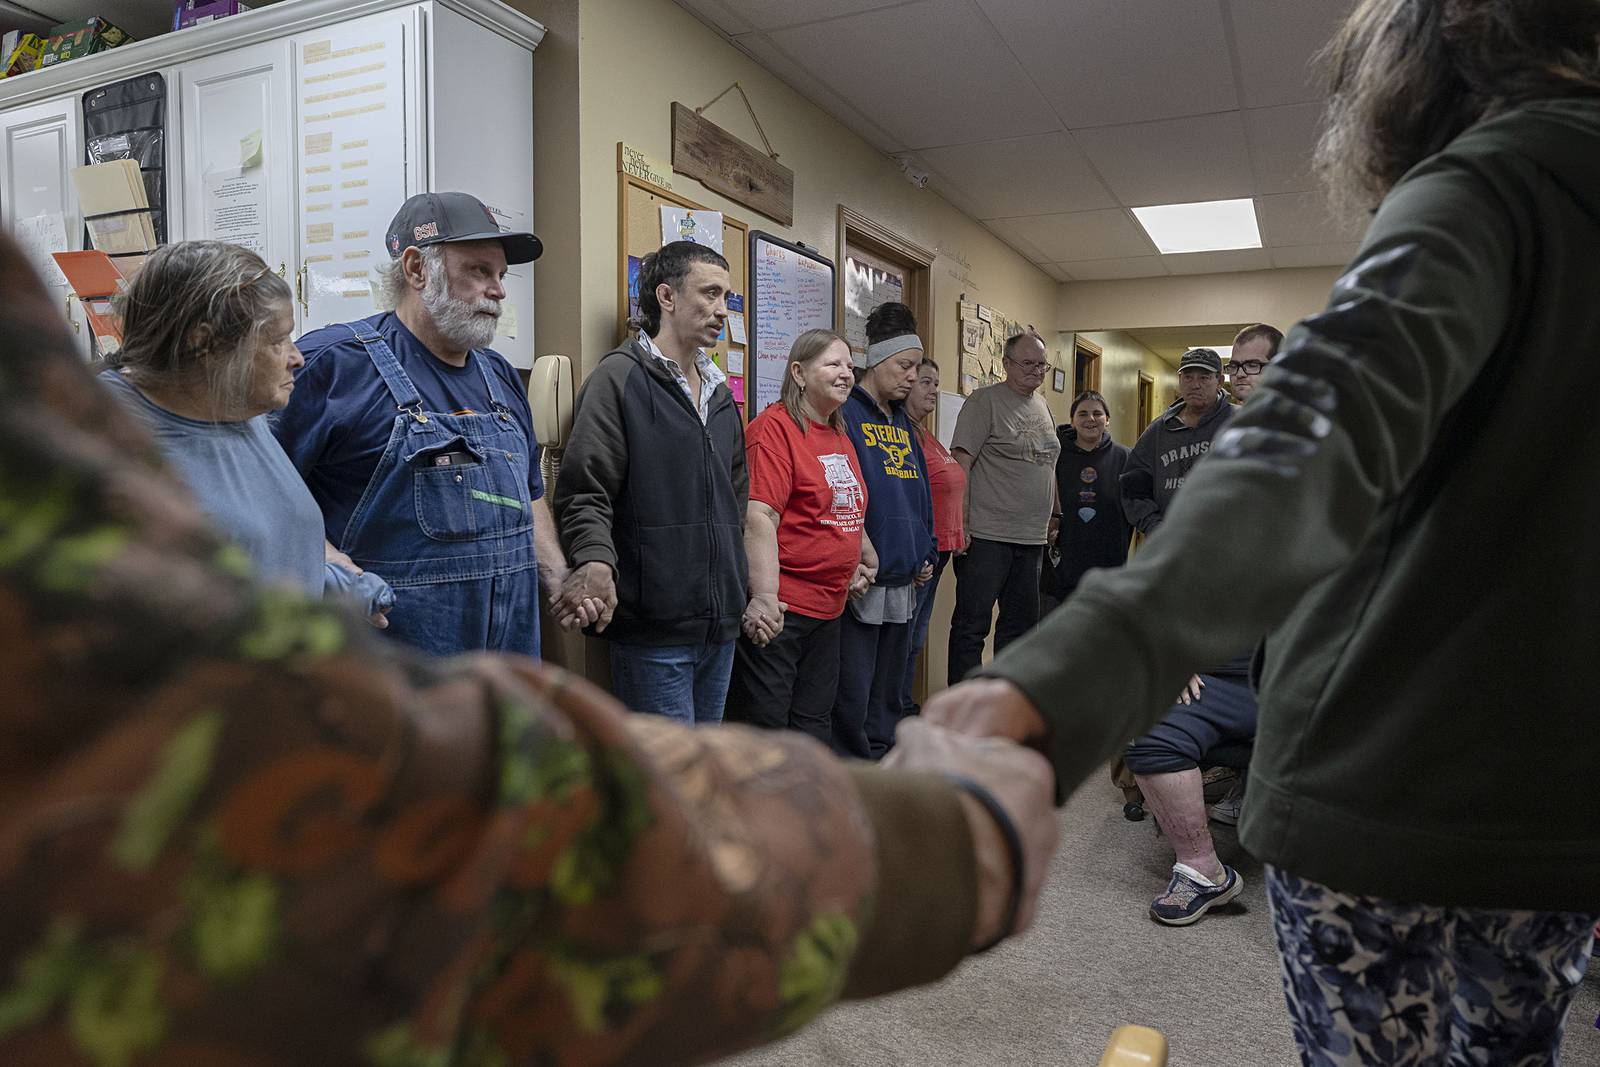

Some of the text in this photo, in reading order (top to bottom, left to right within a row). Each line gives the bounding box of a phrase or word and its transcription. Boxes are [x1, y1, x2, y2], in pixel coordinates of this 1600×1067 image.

[622, 161, 650, 182] NEVER
[649, 172, 665, 186] GIVE
[413, 221, 439, 241] GSH
